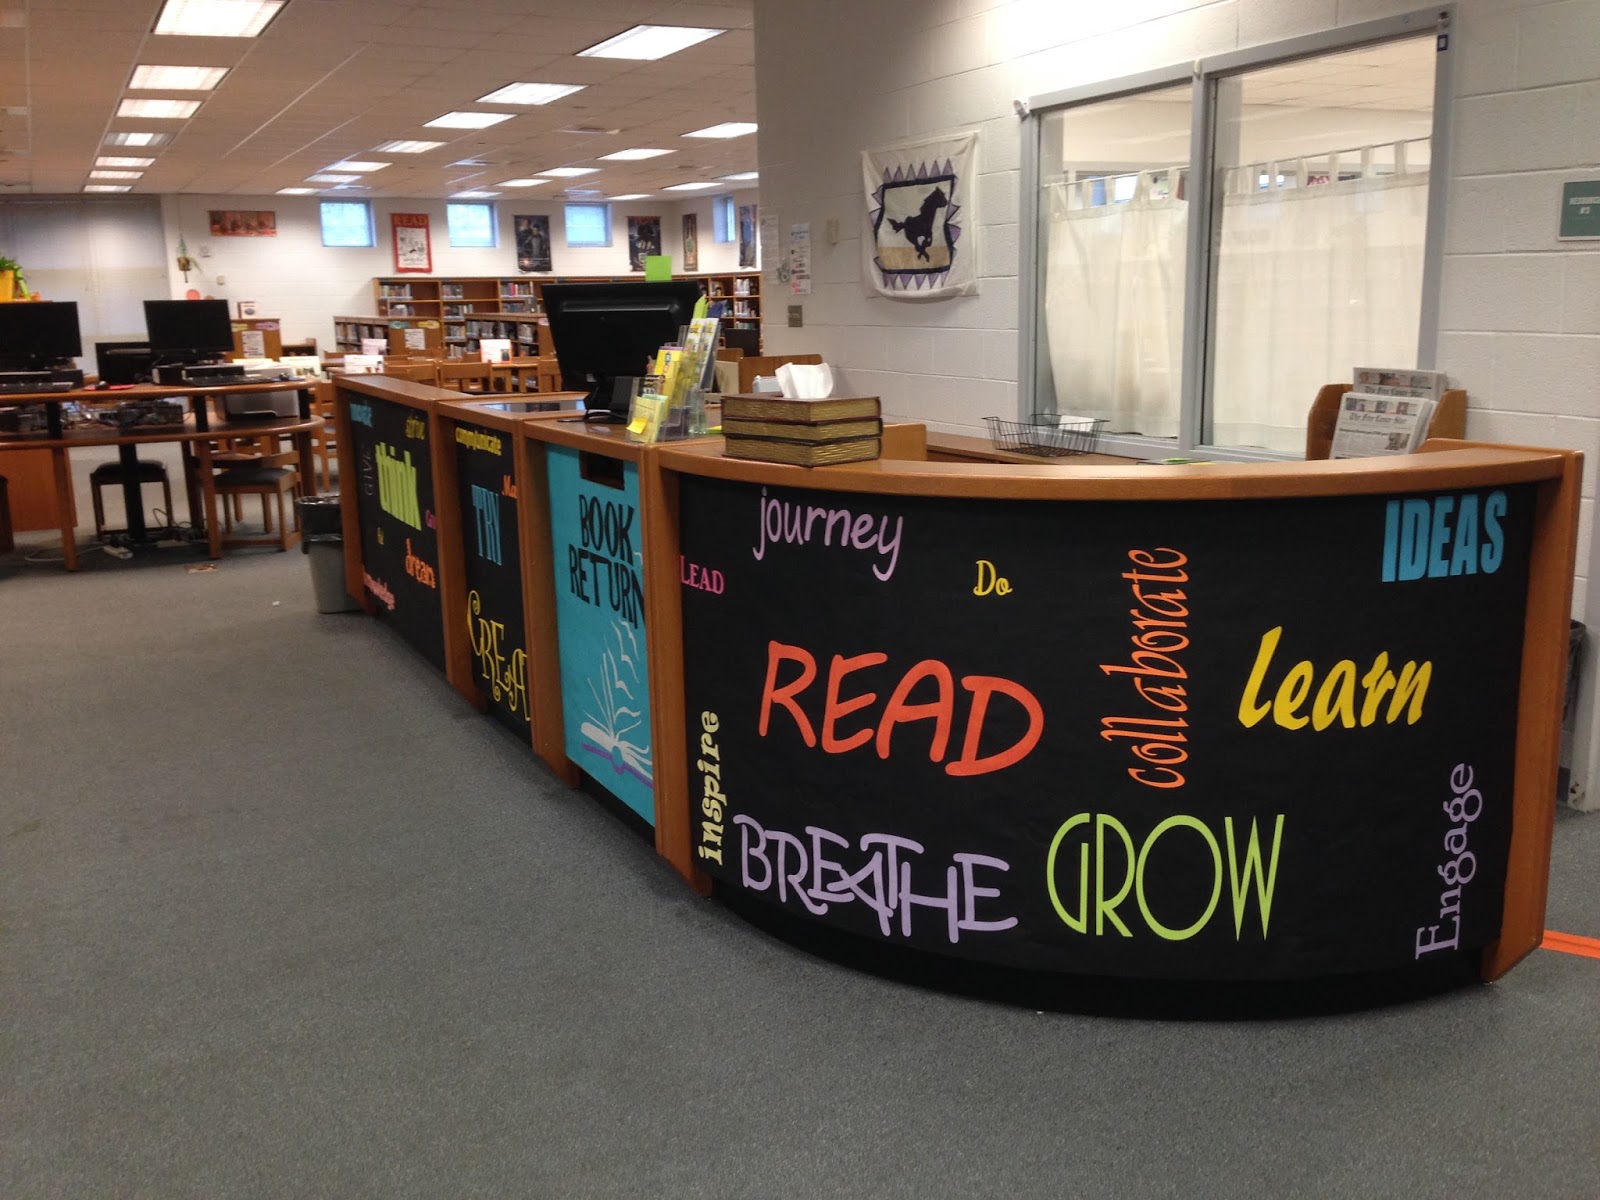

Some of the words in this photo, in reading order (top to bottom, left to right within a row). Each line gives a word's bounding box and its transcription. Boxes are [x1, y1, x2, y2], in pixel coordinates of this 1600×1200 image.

[568, 543, 646, 630] RETURN
[578, 494, 635, 566] BOOK
[680, 555, 725, 595] LEAD
[752, 486, 904, 582] journey
[973, 559, 1013, 597] Do
[1381, 490, 1508, 583] IDEAS
[466, 590, 532, 722] CREA
[758, 640, 1045, 777] READ
[1099, 547, 1190, 789] collaborate
[696, 709, 728, 866] inspire
[732, 814, 1019, 944] BREATHE
[1046, 812, 1285, 942] GROW
[1415, 763, 1484, 960] Engage
